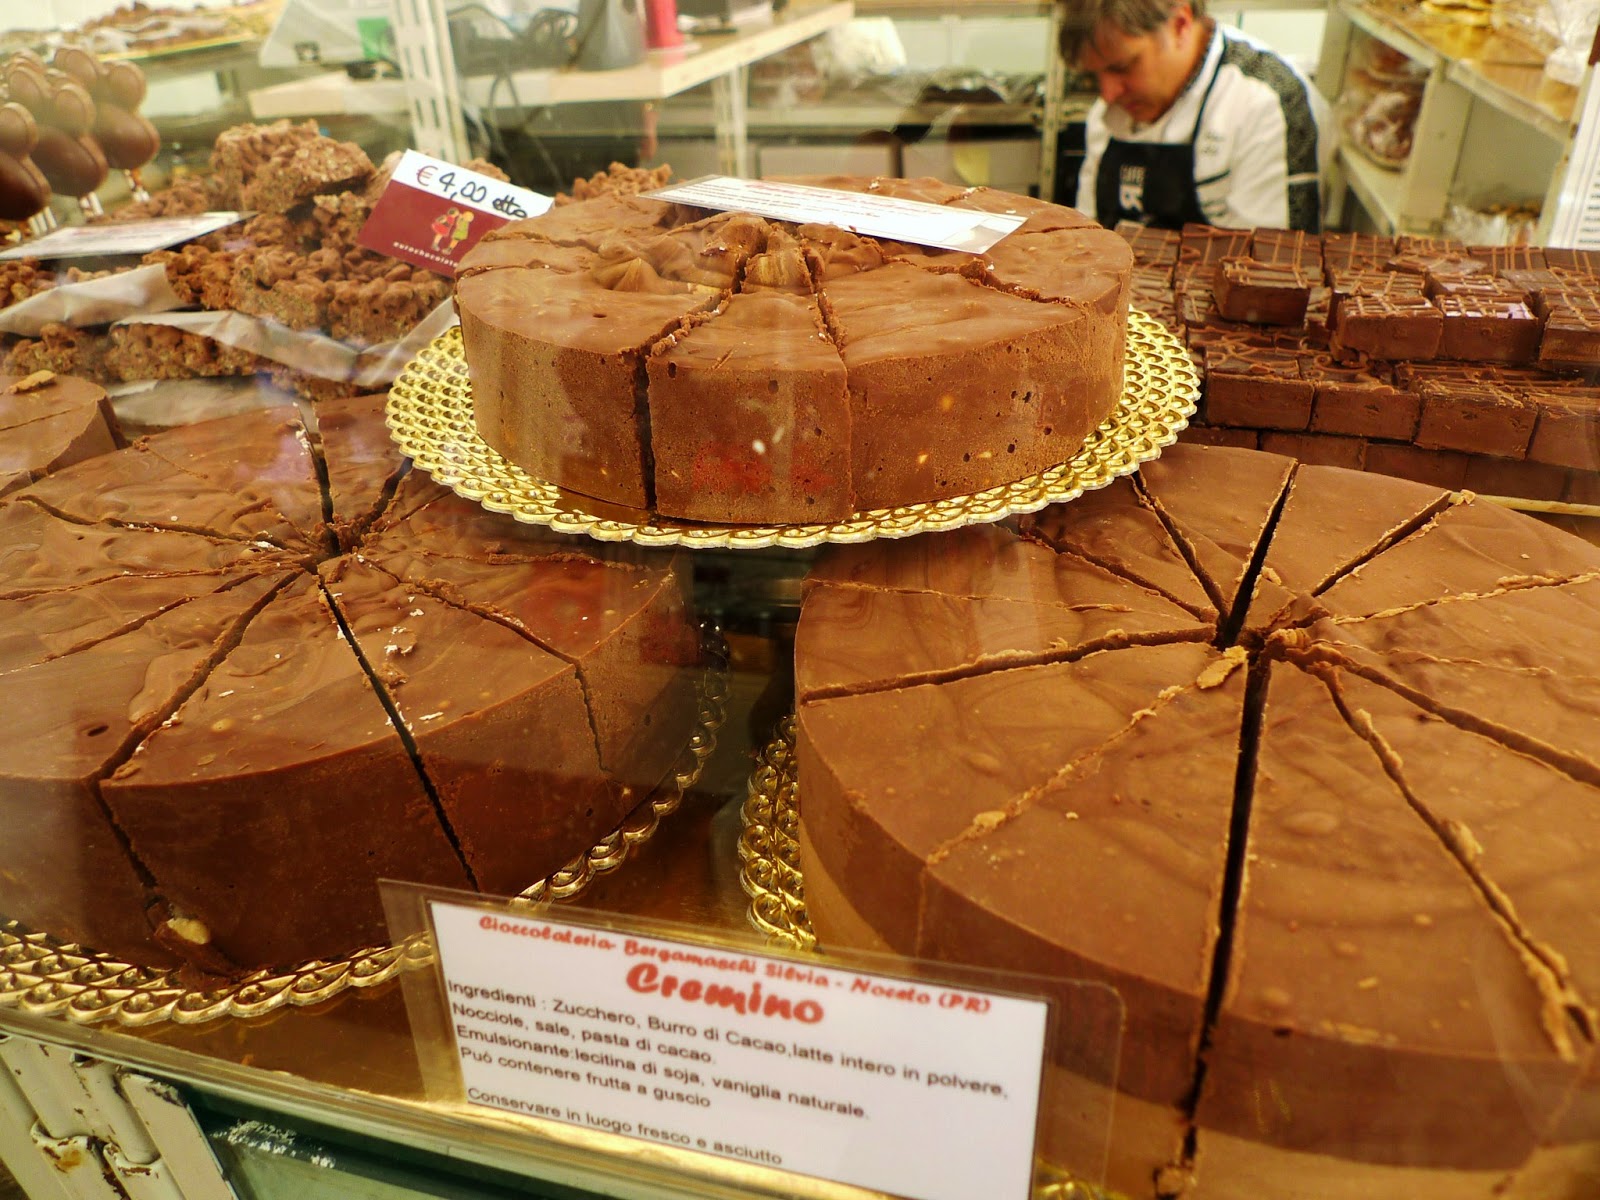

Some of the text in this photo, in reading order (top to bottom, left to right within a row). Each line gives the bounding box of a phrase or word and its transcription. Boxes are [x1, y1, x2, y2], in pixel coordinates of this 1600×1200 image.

[623, 938, 756, 974] Bergamaschi
[764, 962, 829, 988] Silvia
[938, 992, 991, 1014] (PR)
[627, 962, 824, 1023] Cremino
[448, 979, 537, 1009] Ingredienti
[553, 998, 641, 1030] Zucchero,
[647, 1015, 698, 1037] Burro
[703, 1027, 720, 1041] di
[840, 1052, 897, 1076] intero
[902, 1064, 920, 1081] in
[452, 1002, 530, 1031] Nocciole,
[535, 1018, 576, 1040] sale,
[581, 1028, 630, 1048] pasta
[635, 1038, 651, 1051] di
[460, 1046, 711, 1108] Può contenere frutta a guscio
[642, 1062, 657, 1075] di
[663, 1066, 705, 1086] soja,
[712, 1076, 782, 1101] vaniglia
[467, 1087, 783, 1166] Conservare in luogo fresco e asciutto
